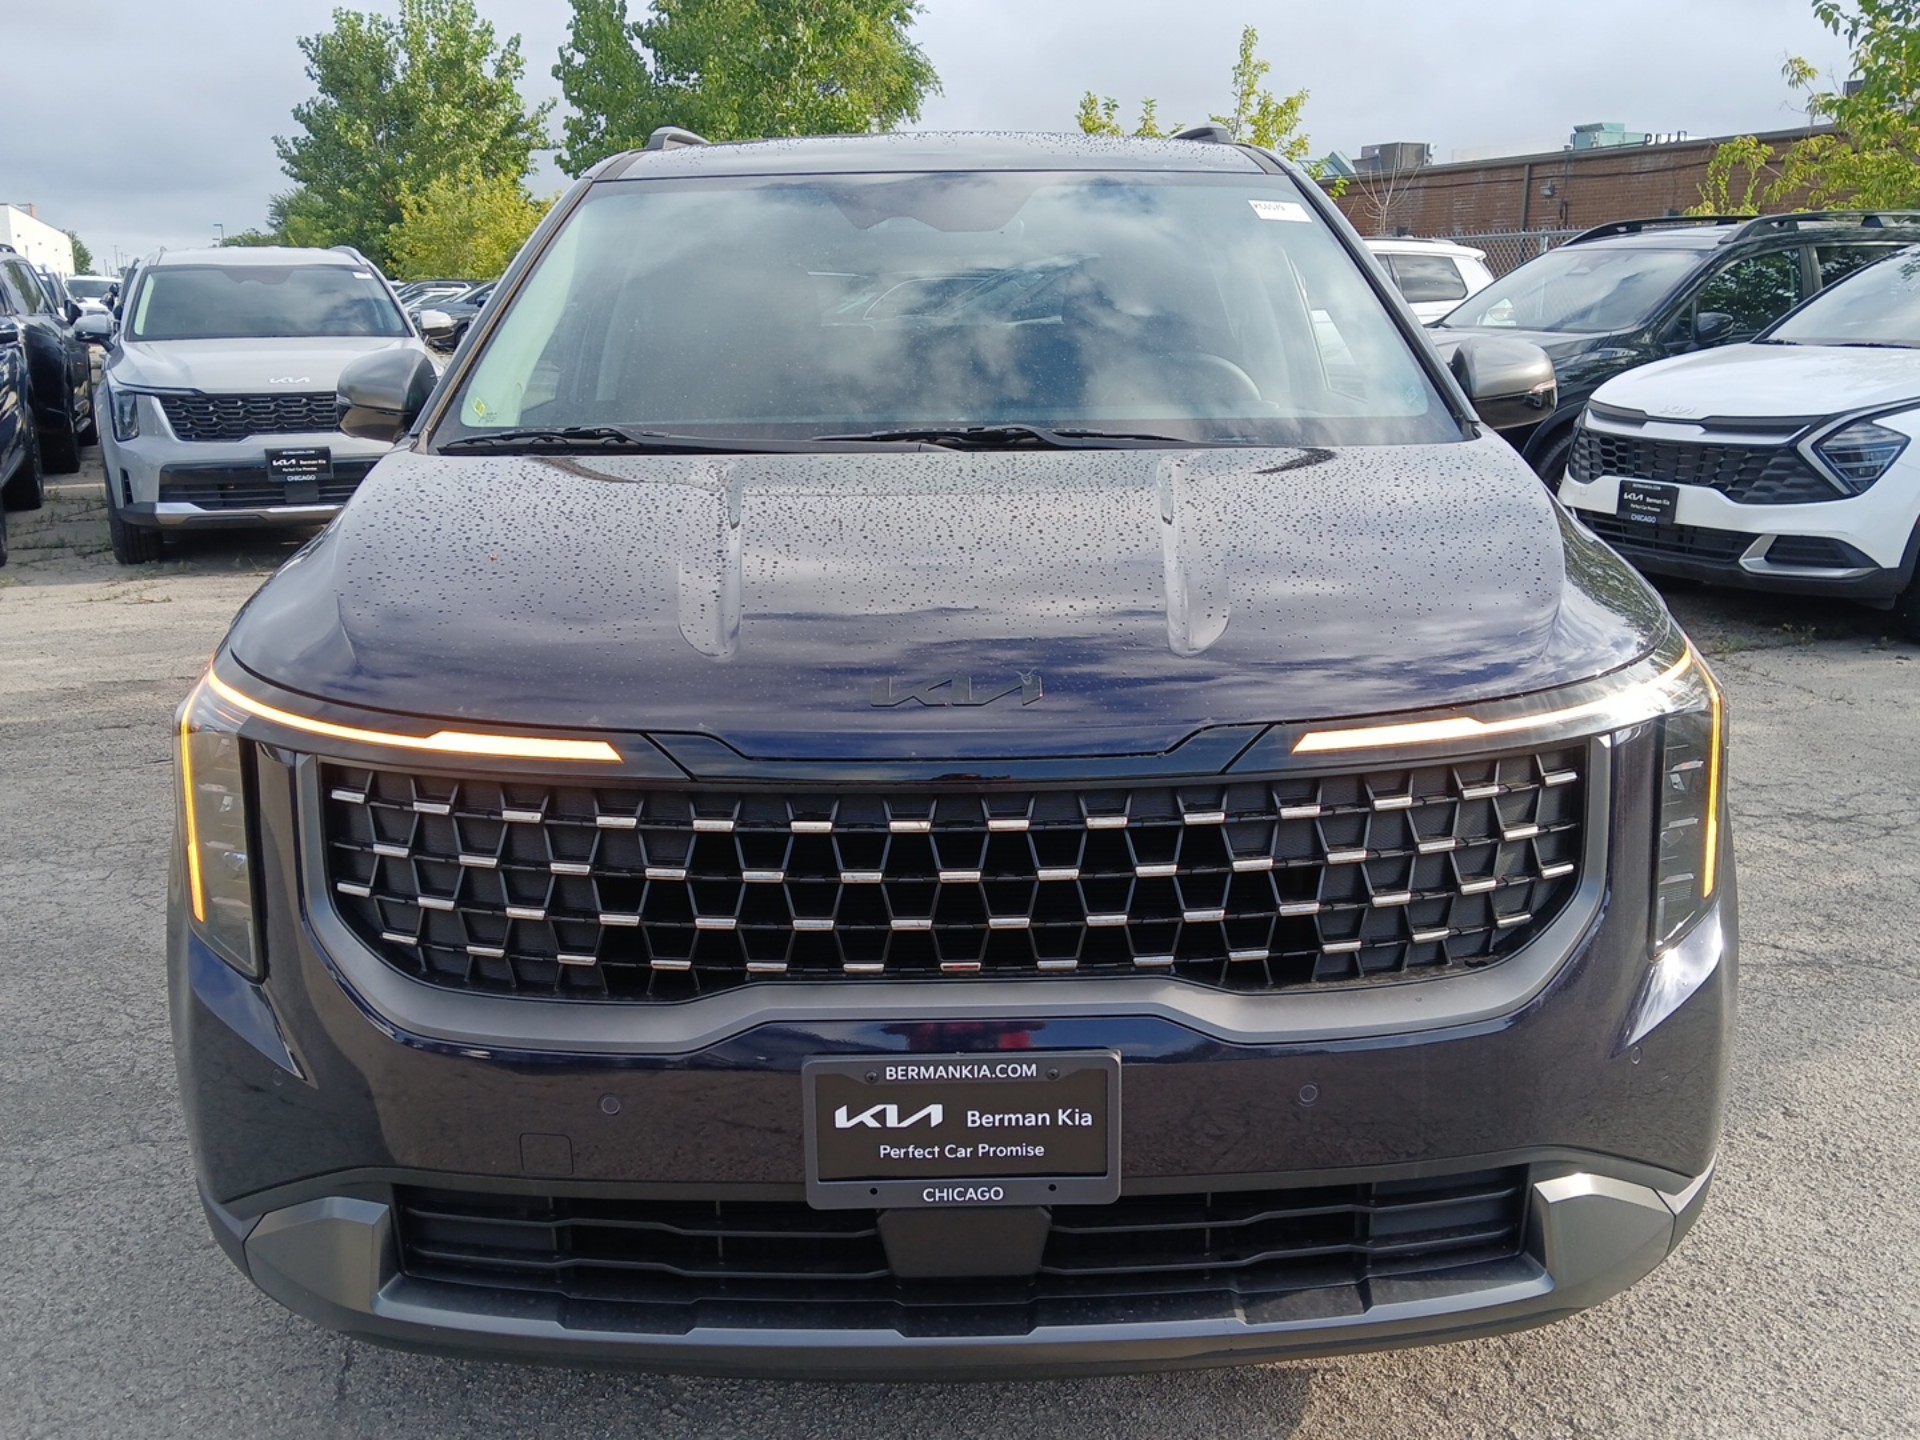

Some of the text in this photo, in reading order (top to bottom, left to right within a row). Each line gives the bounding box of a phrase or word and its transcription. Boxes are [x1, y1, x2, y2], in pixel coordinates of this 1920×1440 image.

[1631, 513, 1657, 524] CHICAGO
[871, 676, 1043, 707] KIA
[885, 1063, 1037, 1081] BERMANKIA.COM
[834, 1103, 1093, 1129] KIA Berman Kia
[879, 1142, 1045, 1159] Perfect Car Promise
[922, 1186, 1004, 1203] CHICAGO
